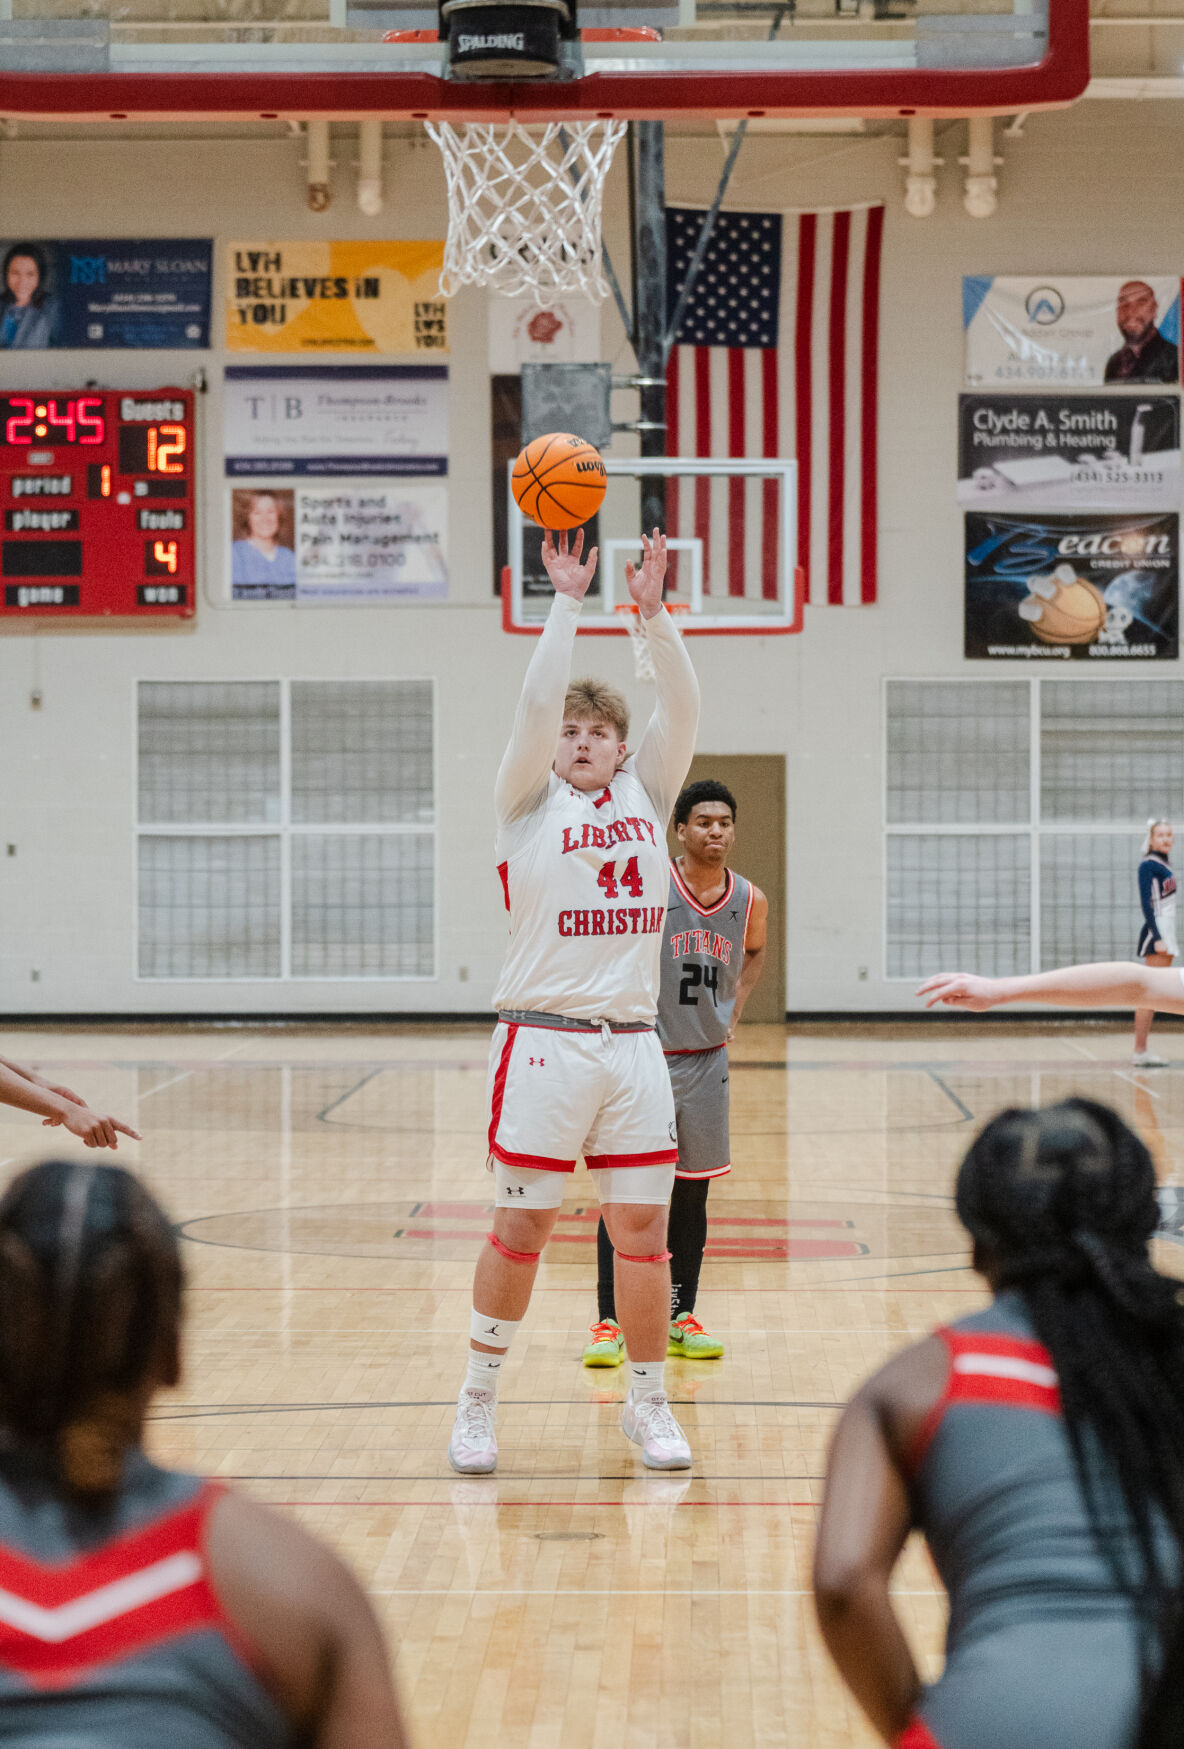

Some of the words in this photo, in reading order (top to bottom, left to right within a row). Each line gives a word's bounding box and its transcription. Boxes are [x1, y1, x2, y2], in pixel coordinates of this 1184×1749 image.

[458, 33, 524, 52] SPALDING
[237, 303, 287, 325] YOU
[414, 335, 446, 348] YOU
[121, 397, 185, 422] Guests
[245, 396, 264, 420] T
[285, 396, 303, 420] B
[6, 397, 105, 445] 2:45
[973, 408, 1030, 433] Clyde
[1034, 409, 1054, 430] A.
[1059, 409, 1118, 430] Smith
[147, 425, 186, 473] 12
[973, 432, 1042, 450] Plumbing
[1045, 433, 1057, 448] &
[1060, 432, 1116, 450] Heating
[12, 475, 71, 498] period
[100, 464, 111, 497] 1
[301, 496, 351, 510] Sports
[358, 496, 387, 508] and
[12, 507, 71, 531] player
[140, 508, 183, 530] fouls
[340, 532, 439, 548] Management
[153, 540, 178, 574] 4
[1134, 558, 1171, 569] UNION
[561, 817, 657, 855] LIBERTY
[596, 856, 644, 899] 44
[670, 929, 733, 966] TITANS
[678, 963, 719, 1008] 24
